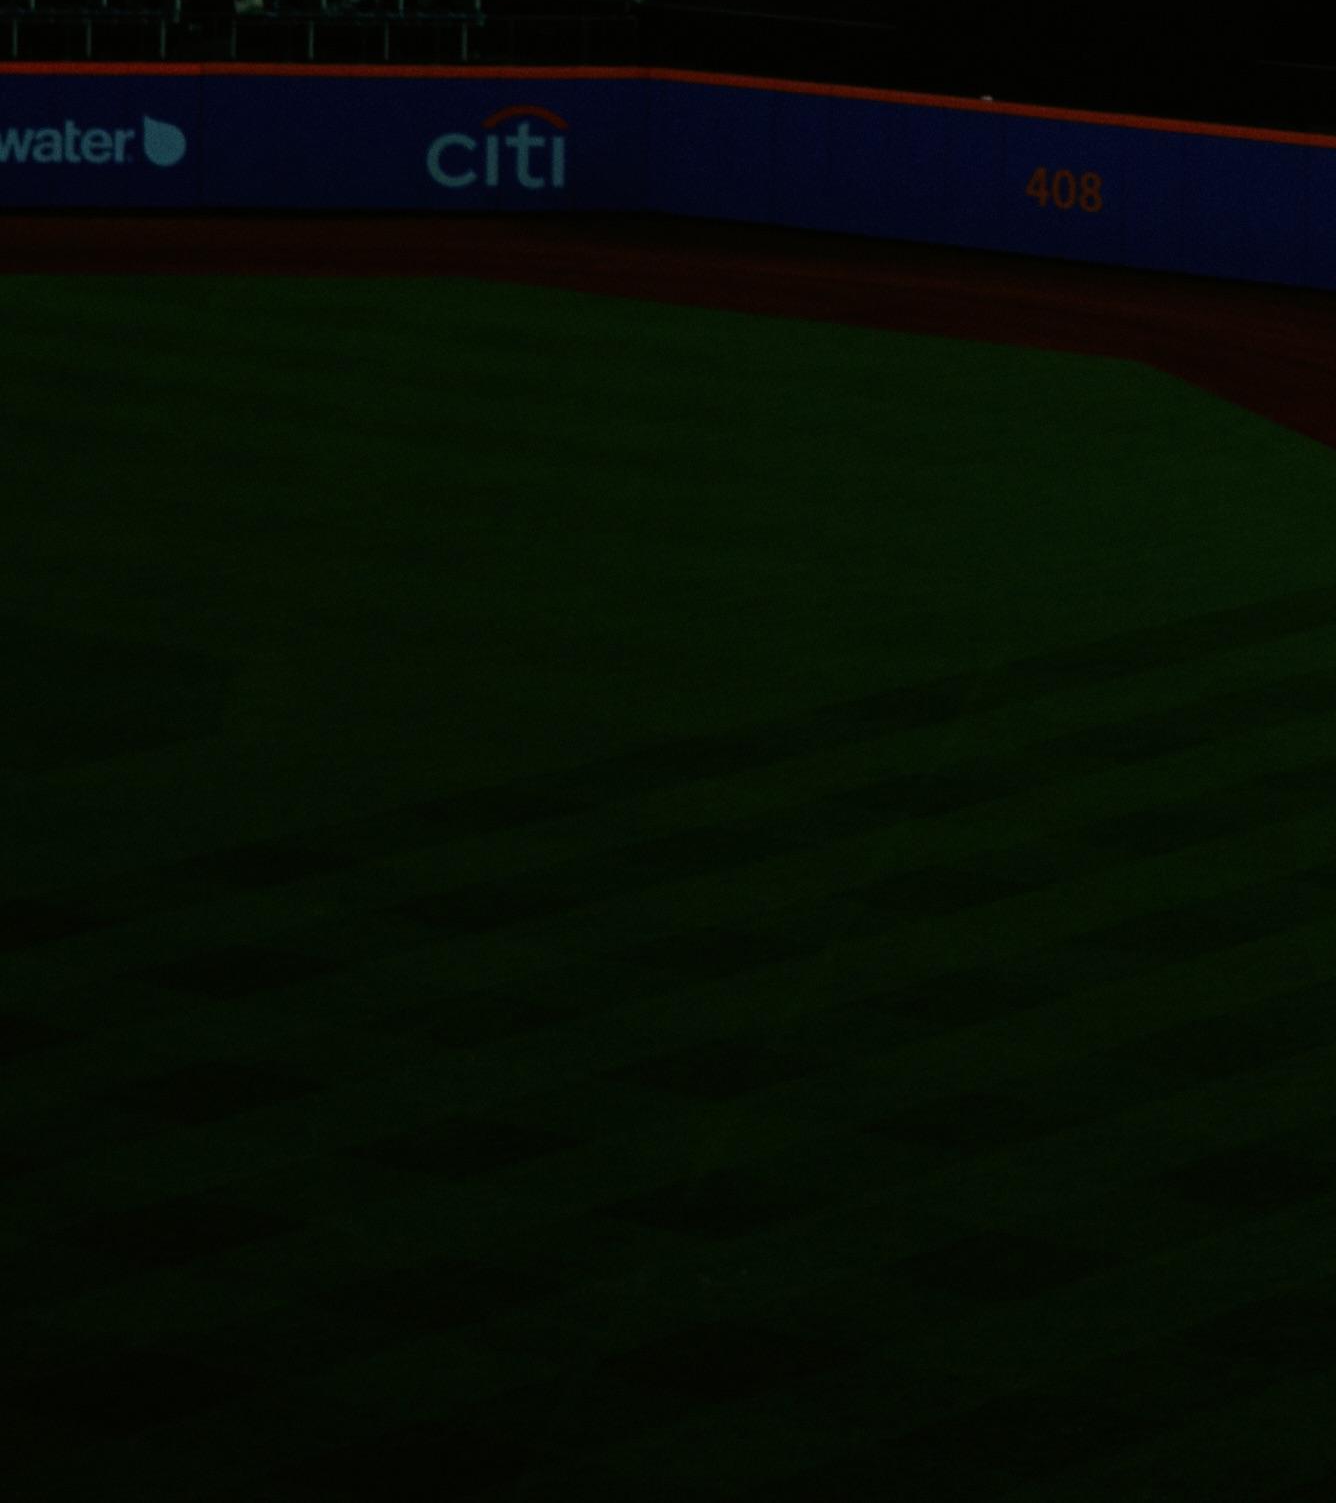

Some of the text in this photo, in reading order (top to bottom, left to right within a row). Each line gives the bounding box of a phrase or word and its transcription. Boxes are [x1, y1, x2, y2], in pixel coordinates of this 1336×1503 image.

[0, 119, 135, 164] water
[426, 122, 566, 190] citi
[1025, 166, 1103, 215] 408
